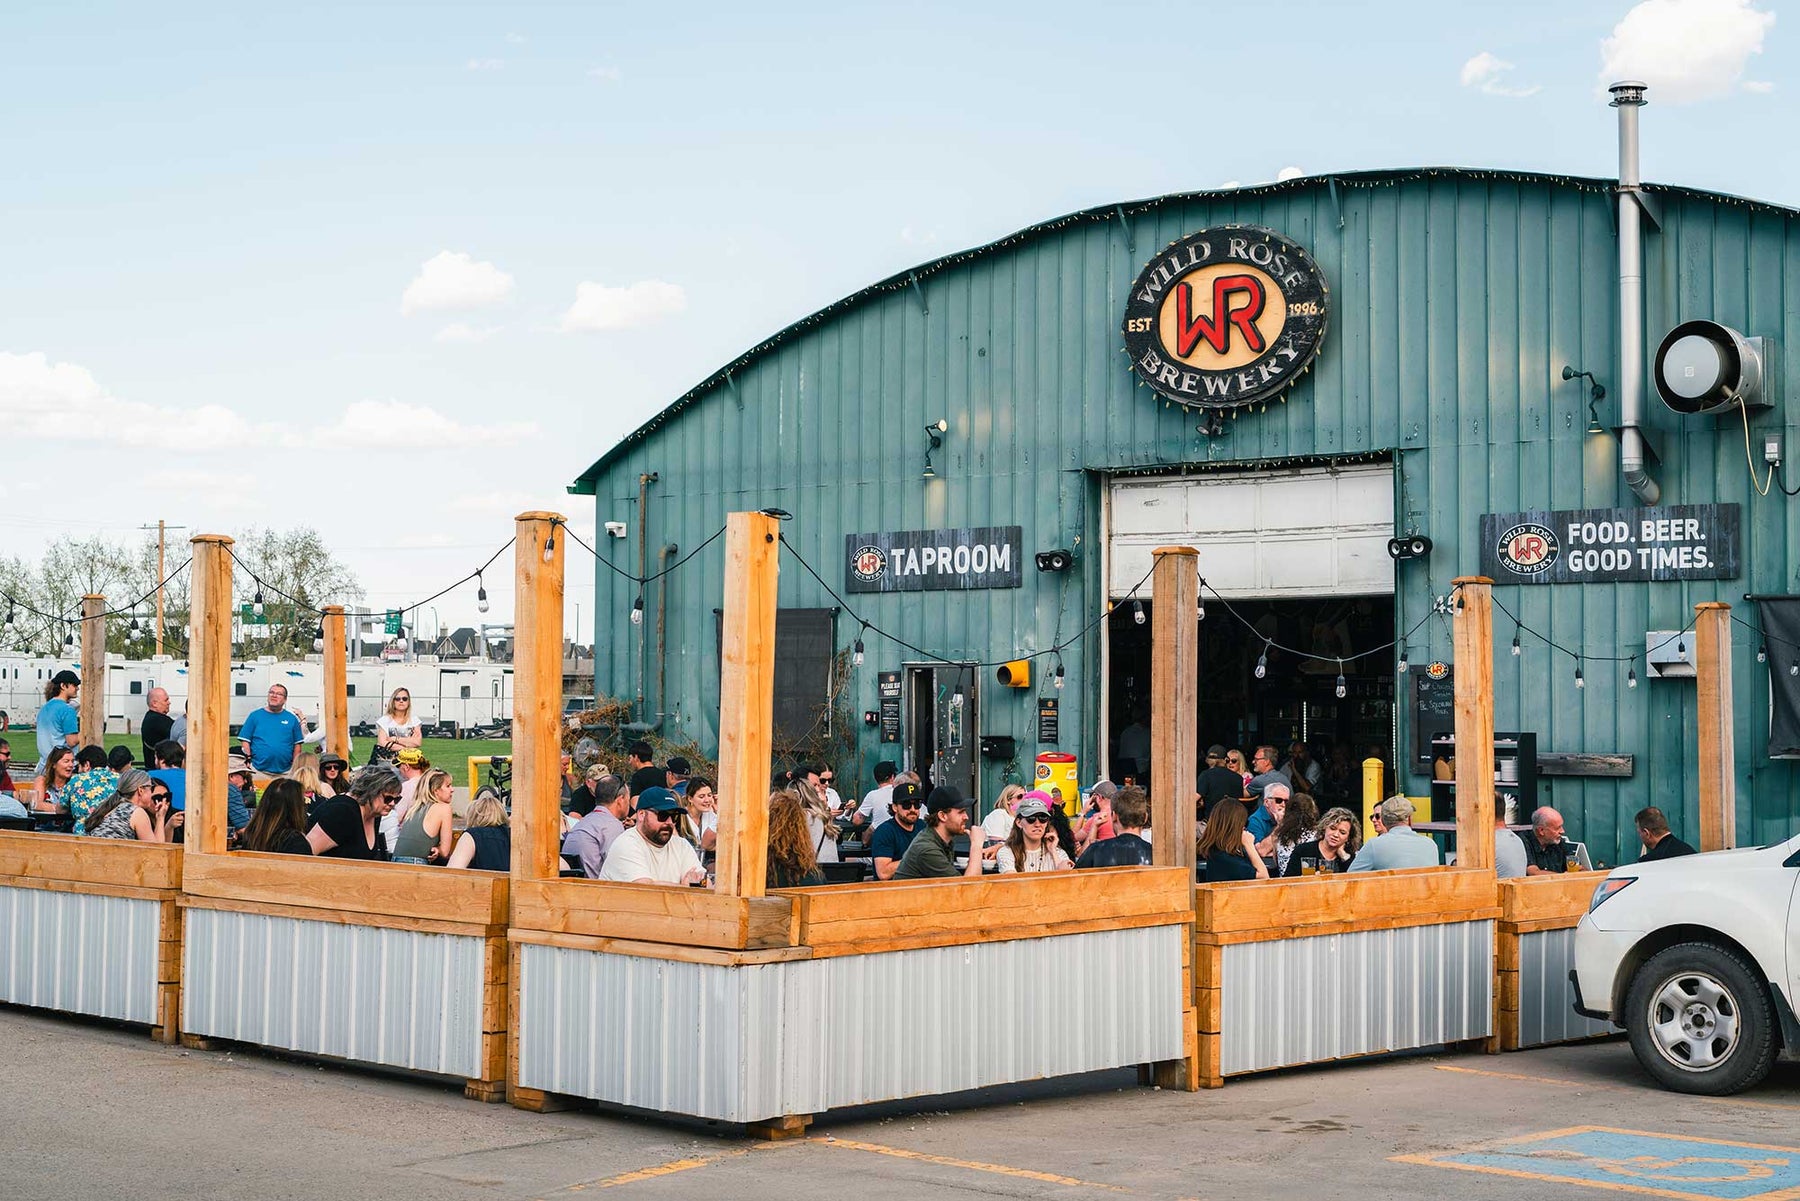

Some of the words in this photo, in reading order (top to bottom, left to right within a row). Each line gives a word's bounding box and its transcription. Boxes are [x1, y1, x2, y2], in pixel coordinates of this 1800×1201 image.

[1137, 242, 1211, 305] WILD
[1227, 237, 1304, 295] ROSE
[1177, 274, 1266, 358] WR
[1288, 303, 1318, 315] 1996
[1128, 317, 1153, 332] EST
[1139, 340, 1299, 396] BREWERY
[1502, 526, 1526, 545] WILD
[1530, 526, 1554, 545] ROSE
[1568, 521, 1636, 545] FOOD.
[1641, 518, 1706, 542] BEER.
[891, 543, 1011, 576] TAPROOM
[1515, 537, 1542, 560] WR
[1568, 548, 1632, 572] GOOD
[1637, 546, 1714, 570] TIMES.
[861, 555, 877, 571] WR
[1503, 555, 1552, 573] BREWERY
[908, 785, 915, 795] P
